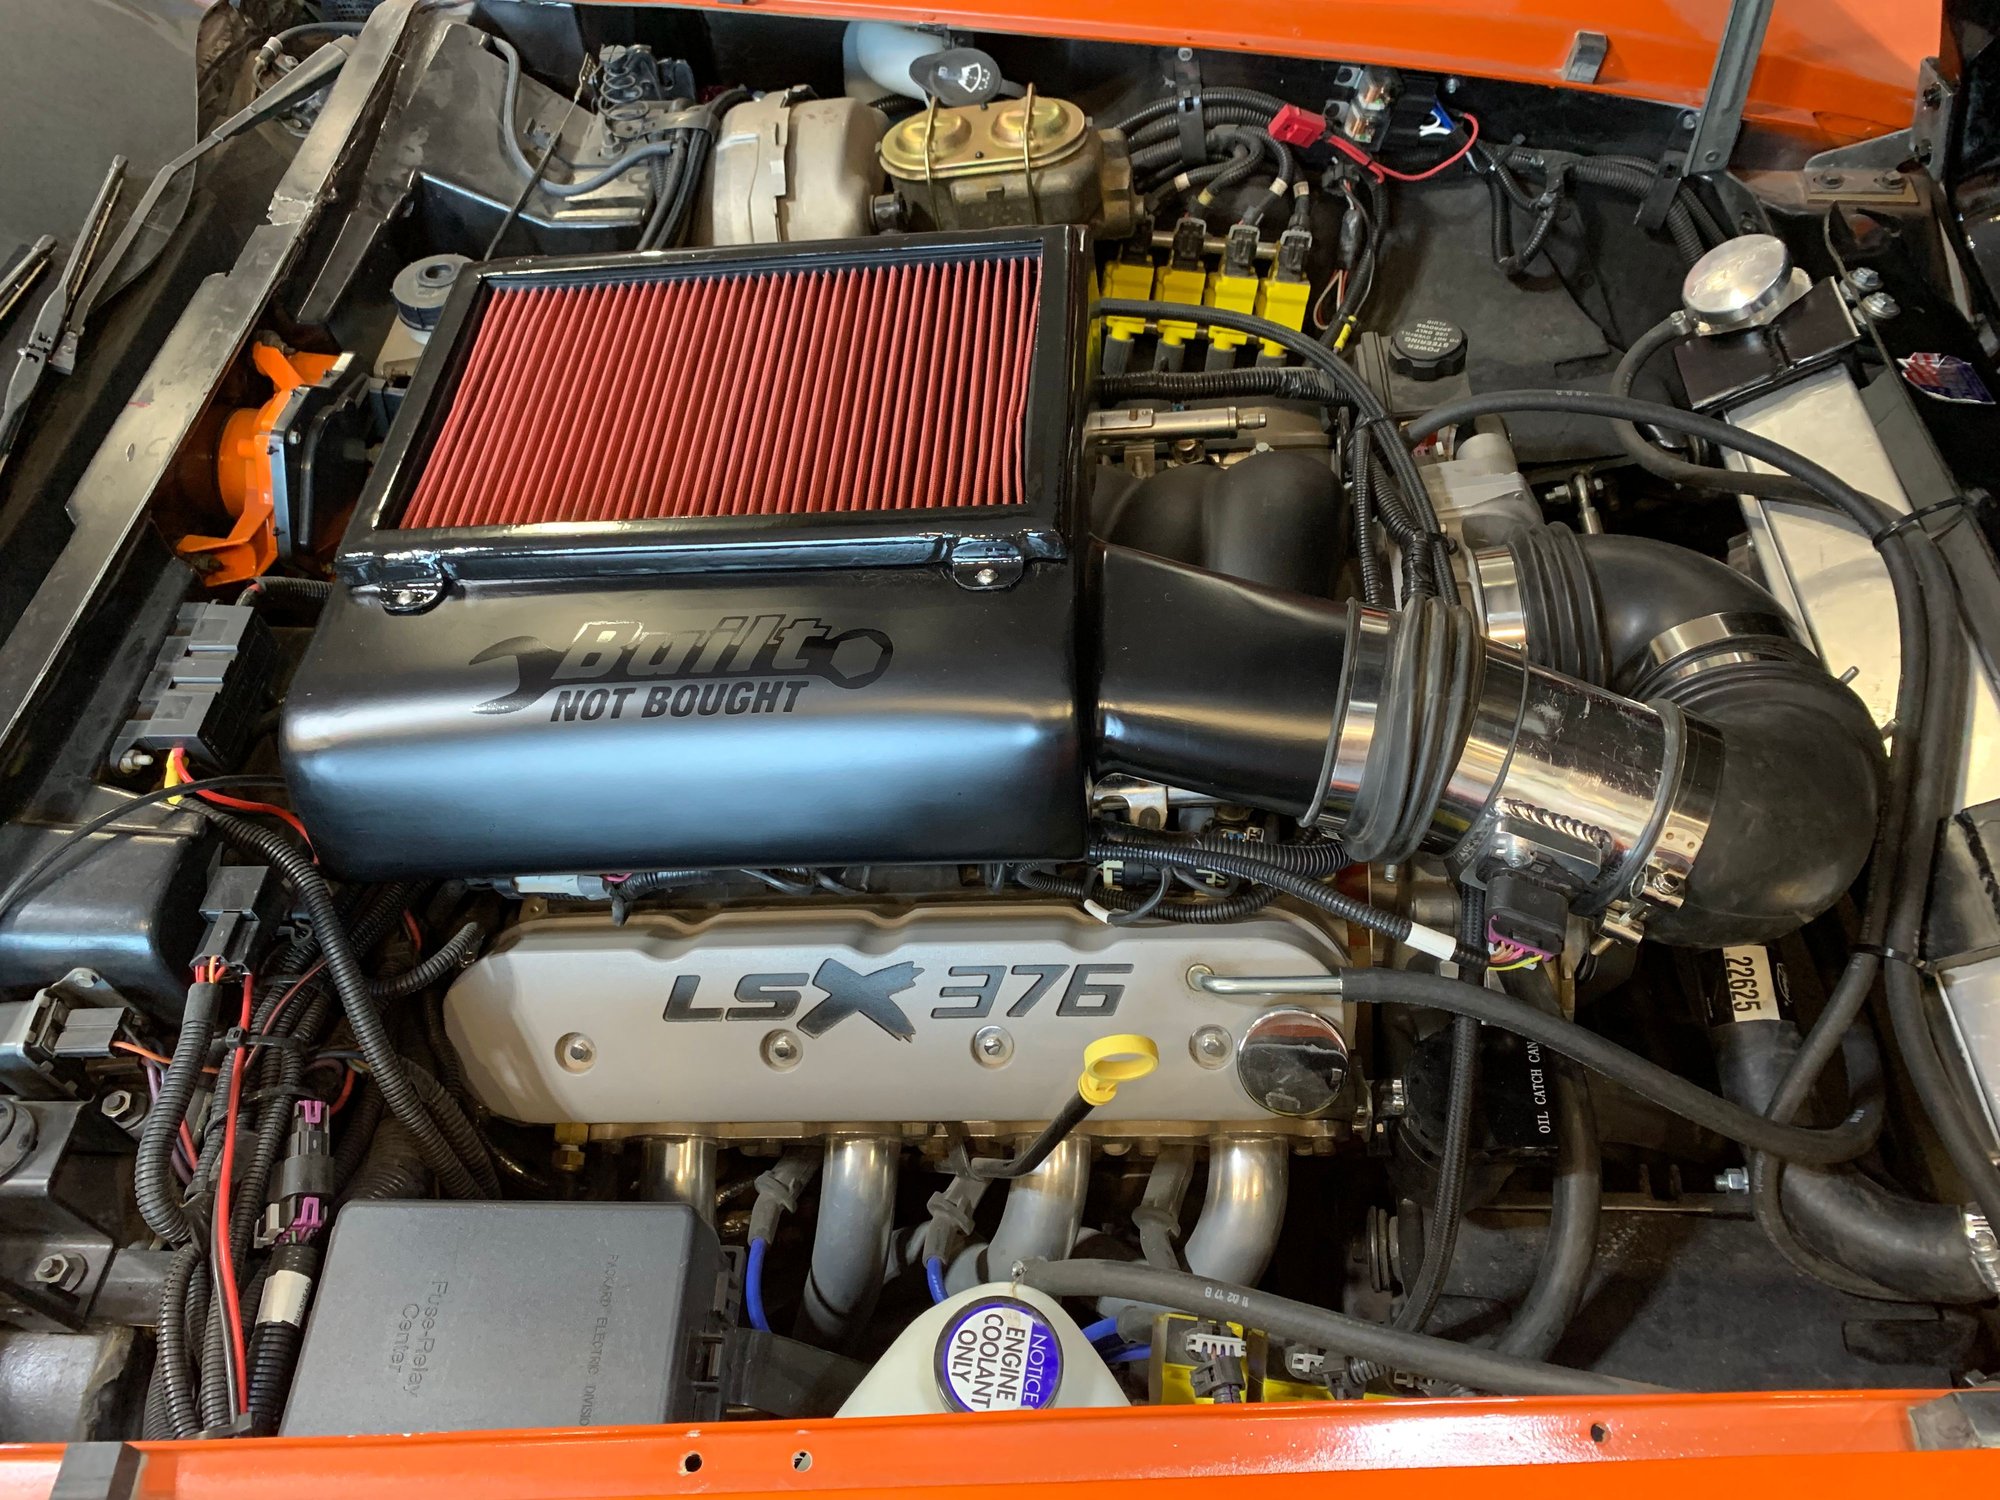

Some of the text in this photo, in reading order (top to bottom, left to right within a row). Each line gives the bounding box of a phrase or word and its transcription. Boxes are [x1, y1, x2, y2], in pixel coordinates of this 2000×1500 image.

[1404, 336, 1449, 348] STEERING
[1407, 343, 1440, 352] POWER
[1416, 323, 1452, 332] APPROVED
[553, 614, 834, 679] Built
[550, 680, 809, 722] NOT BOUGHT
[663, 957, 1134, 1043] LSX 376
[1725, 956, 1762, 1012] 22625
[1526, 1040, 1551, 1134] OIL CATCH CAN
[597, 1254, 619, 1309] PACKARD
[388, 1303, 420, 1374] Center
[403, 1280, 449, 1398] Fuse-Relay
[587, 1316, 608, 1376] ELECTRIC
[951, 1329, 977, 1383] ONLY
[971, 1314, 1004, 1409] COOLANT
[996, 1327, 1026, 1402] ENGINE
[1024, 1334, 1048, 1403] NOTICE
